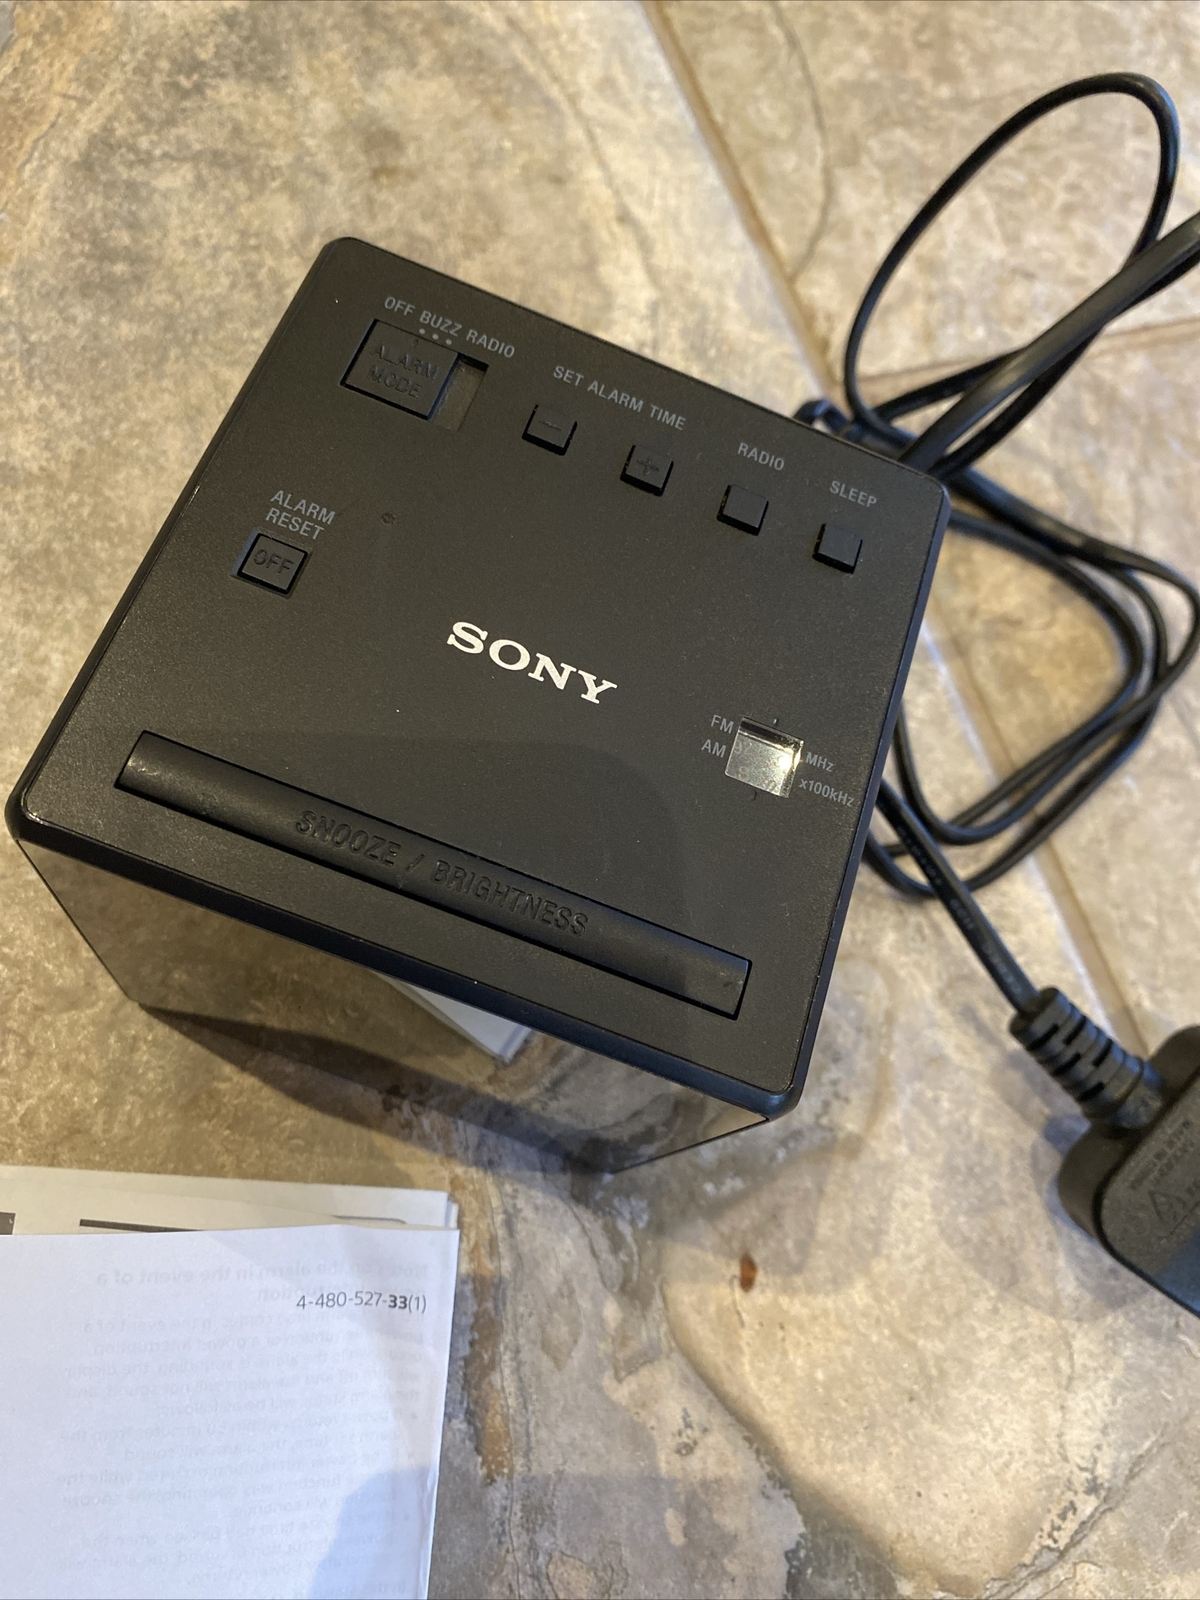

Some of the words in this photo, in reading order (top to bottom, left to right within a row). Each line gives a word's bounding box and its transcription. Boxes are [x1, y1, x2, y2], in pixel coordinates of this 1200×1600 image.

[384, 296, 415, 317] OFF
[419, 310, 459, 337] BUZZ
[466, 329, 516, 359] RADIO
[374, 345, 440, 382] ALARM
[368, 365, 424, 399] MODE
[553, 366, 585, 388] SET
[587, 380, 645, 413] ALARM
[650, 404, 687, 431] TIME
[737, 442, 785, 472] RADIO
[270, 490, 336, 525] ALARM
[829, 480, 878, 508] SLEEP
[265, 507, 325, 540] RESET
[253, 549, 295, 574] OFF
[446, 621, 618, 704] SONY
[710, 714, 735, 734] FM
[700, 738, 727, 759] AM
[805, 751, 835, 773] MHz
[799, 778, 855, 808] x100kHz
[295, 810, 401, 867] SNOOZE
[430, 859, 590, 936] BRIGHTNESS
[296, 1291, 427, 1314] 4-480-527-33(1)
